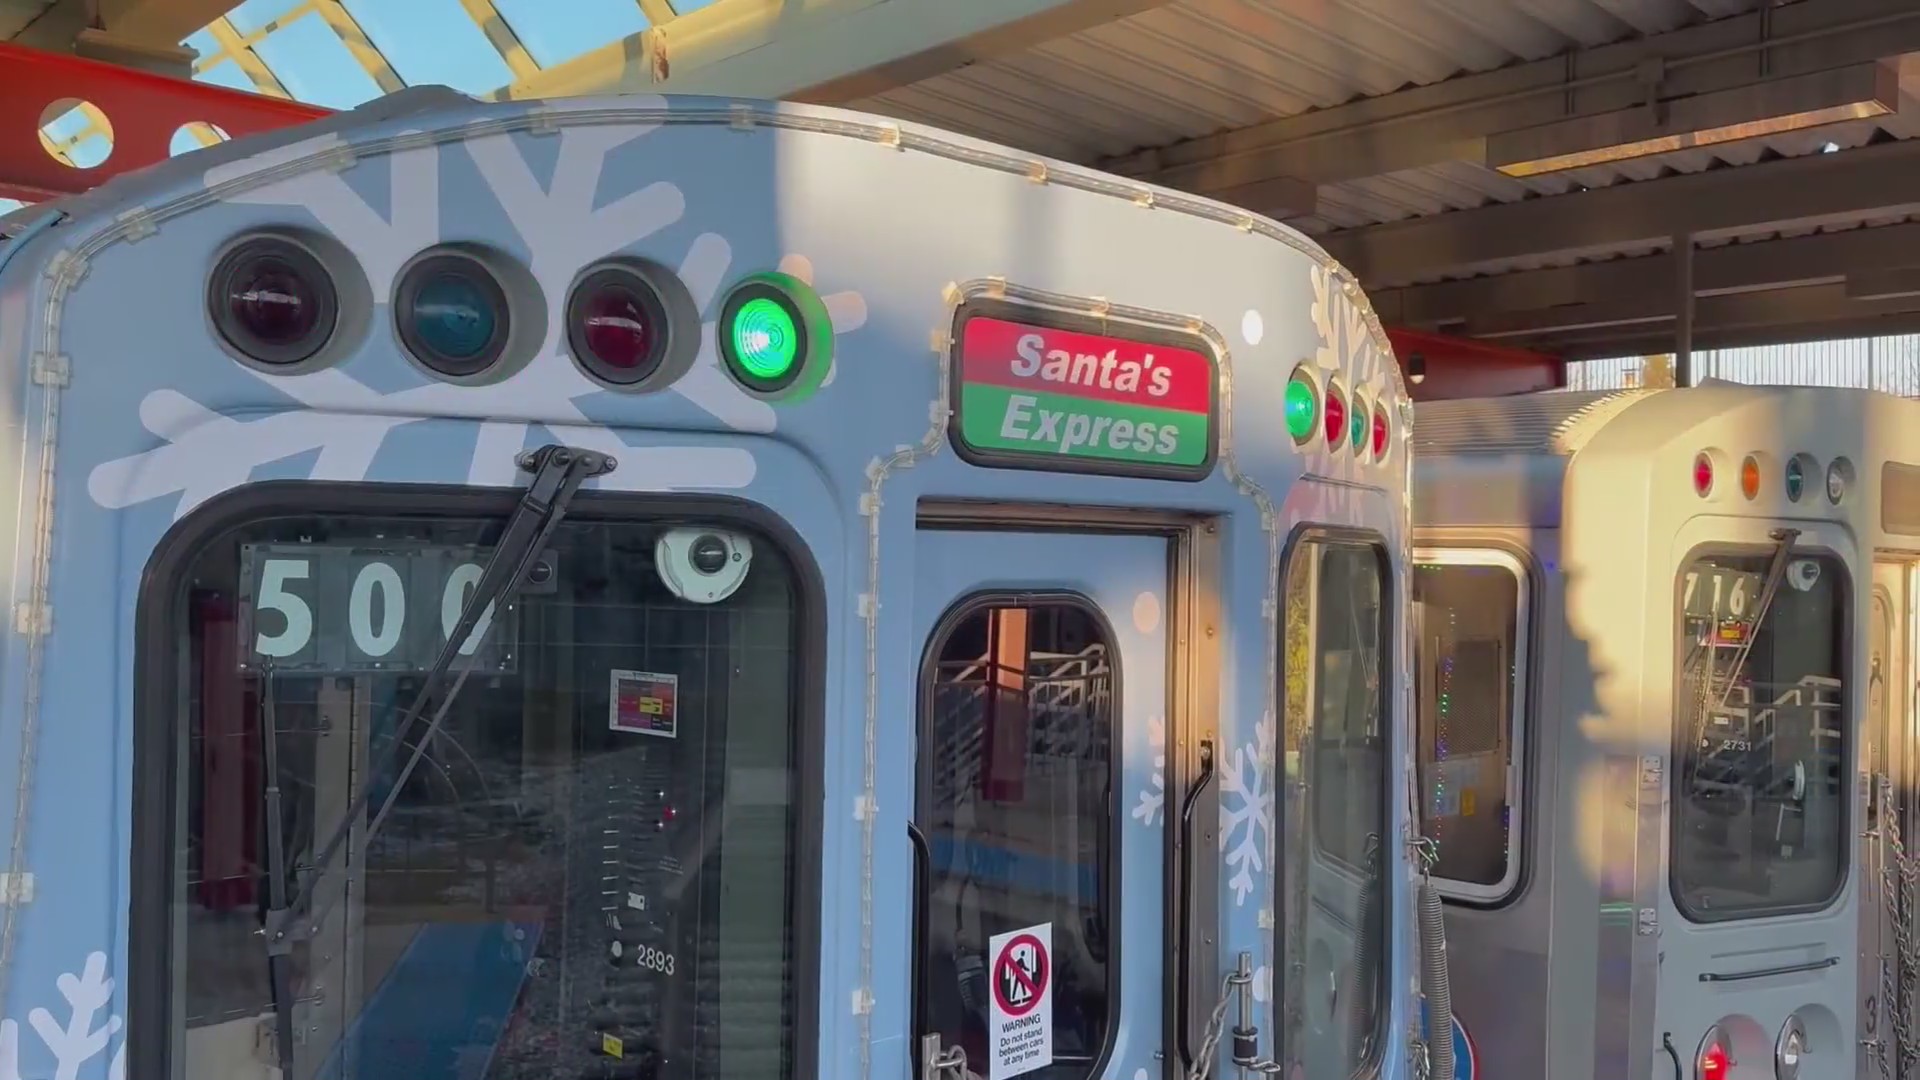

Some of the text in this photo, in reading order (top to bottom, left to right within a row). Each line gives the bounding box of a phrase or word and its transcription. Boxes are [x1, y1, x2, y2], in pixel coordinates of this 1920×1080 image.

[1010, 333, 1172, 397] Santa's
[1000, 394, 1179, 455] Express
[1684, 572, 1746, 615] 716
[1723, 739, 1752, 752] 2731
[637, 944, 675, 976] 2893
[1002, 1013, 1041, 1033] WARNING
[1000, 1026, 1043, 1047] Do not stand
[999, 1038, 1044, 1057] between cars
[1003, 1048, 1040, 1066] at any time
